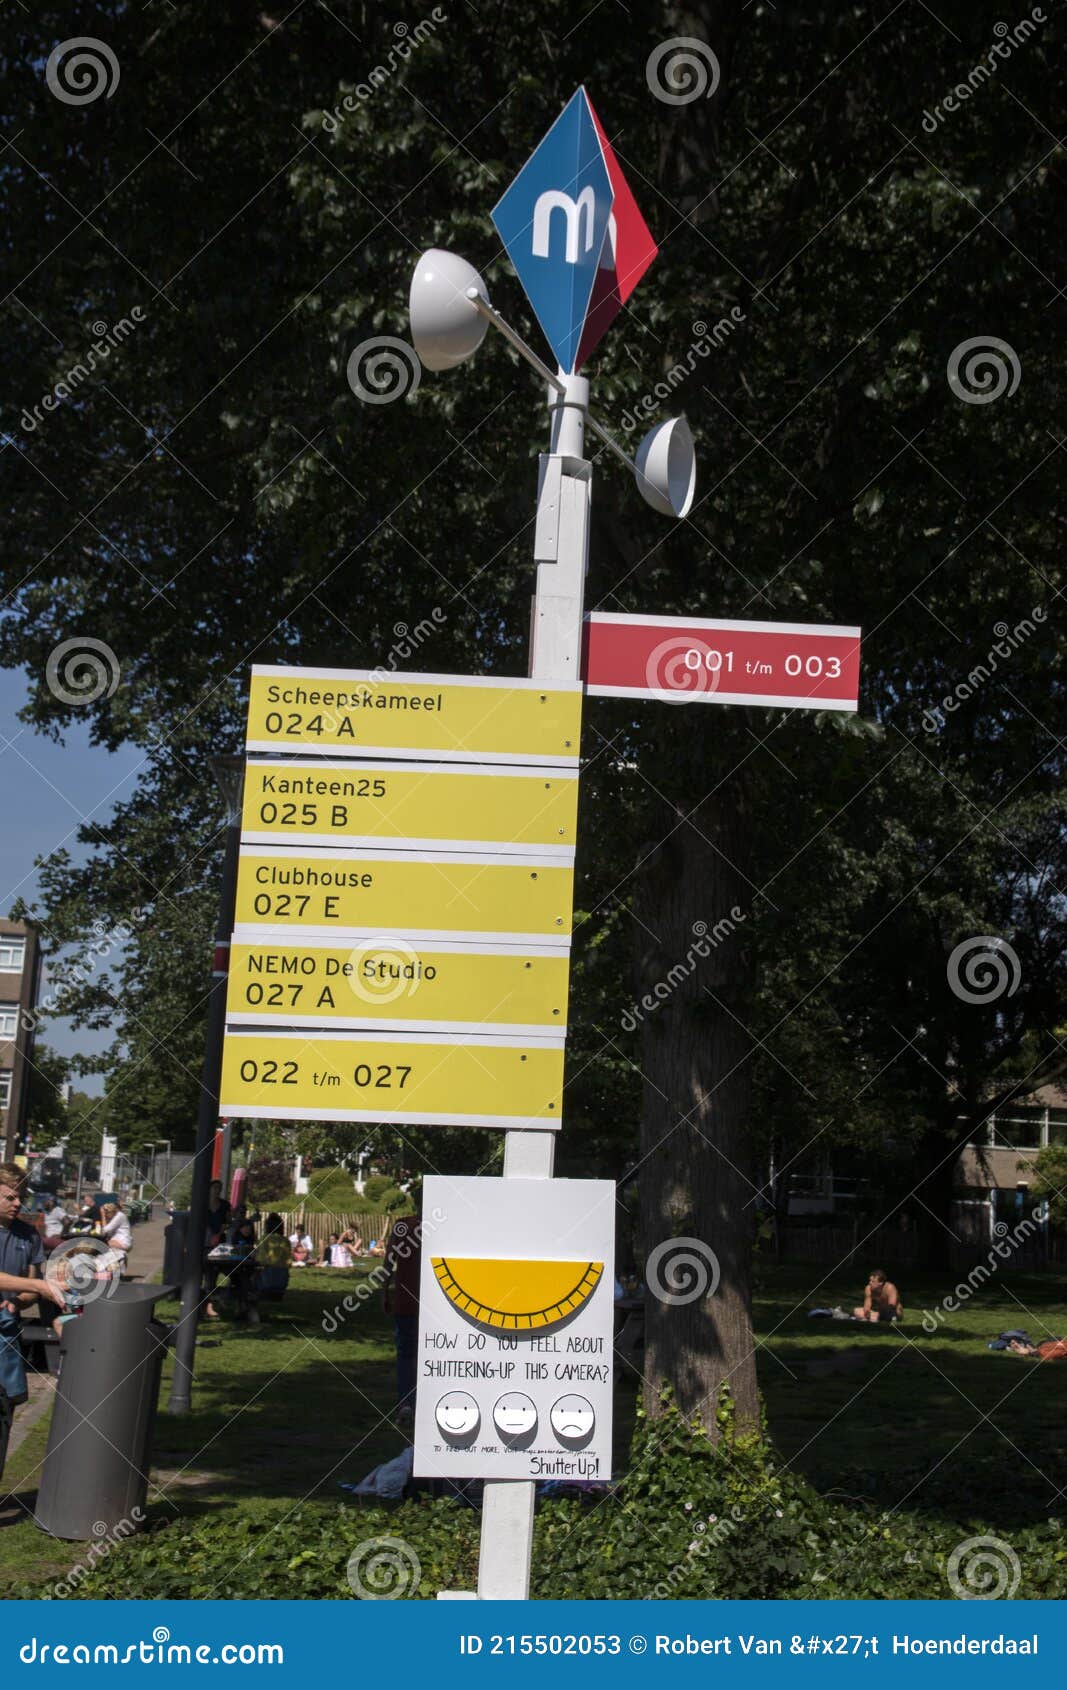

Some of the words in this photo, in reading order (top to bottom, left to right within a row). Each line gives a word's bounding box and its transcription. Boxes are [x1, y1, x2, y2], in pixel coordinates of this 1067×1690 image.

[532, 185, 596, 264] m
[684, 649, 734, 672] 001
[745, 660, 773, 675] t/m
[784, 655, 841, 678] 003
[267, 686, 442, 712] Scheepskameel
[265, 713, 324, 736] 024
[337, 717, 355, 737] A
[262, 776, 386, 797] Kanteen25
[260, 803, 317, 825] 025
[331, 806, 348, 827] B
[256, 867, 373, 888] Clubhouse
[254, 894, 310, 917] 027
[325, 896, 340, 918] E
[248, 955, 316, 975] NEMO
[326, 958, 353, 976] De
[363, 960, 436, 980] Studio
[246, 983, 303, 1006] 027
[317, 986, 335, 1008] A
[240, 1060, 298, 1083] 022
[313, 1072, 340, 1086] t/m
[354, 1065, 411, 1088] 027
[424, 1333, 459, 1350] HOW
[468, 1335, 486, 1350] DO
[497, 1336, 518, 1351] YOU
[531, 1337, 561, 1353] FEEL
[566, 1337, 604, 1353] ABOUT
[423, 1360, 516, 1379] SHUTTERING-UP
[525, 1363, 548, 1380] THIS
[555, 1364, 610, 1384] CAMERA?
